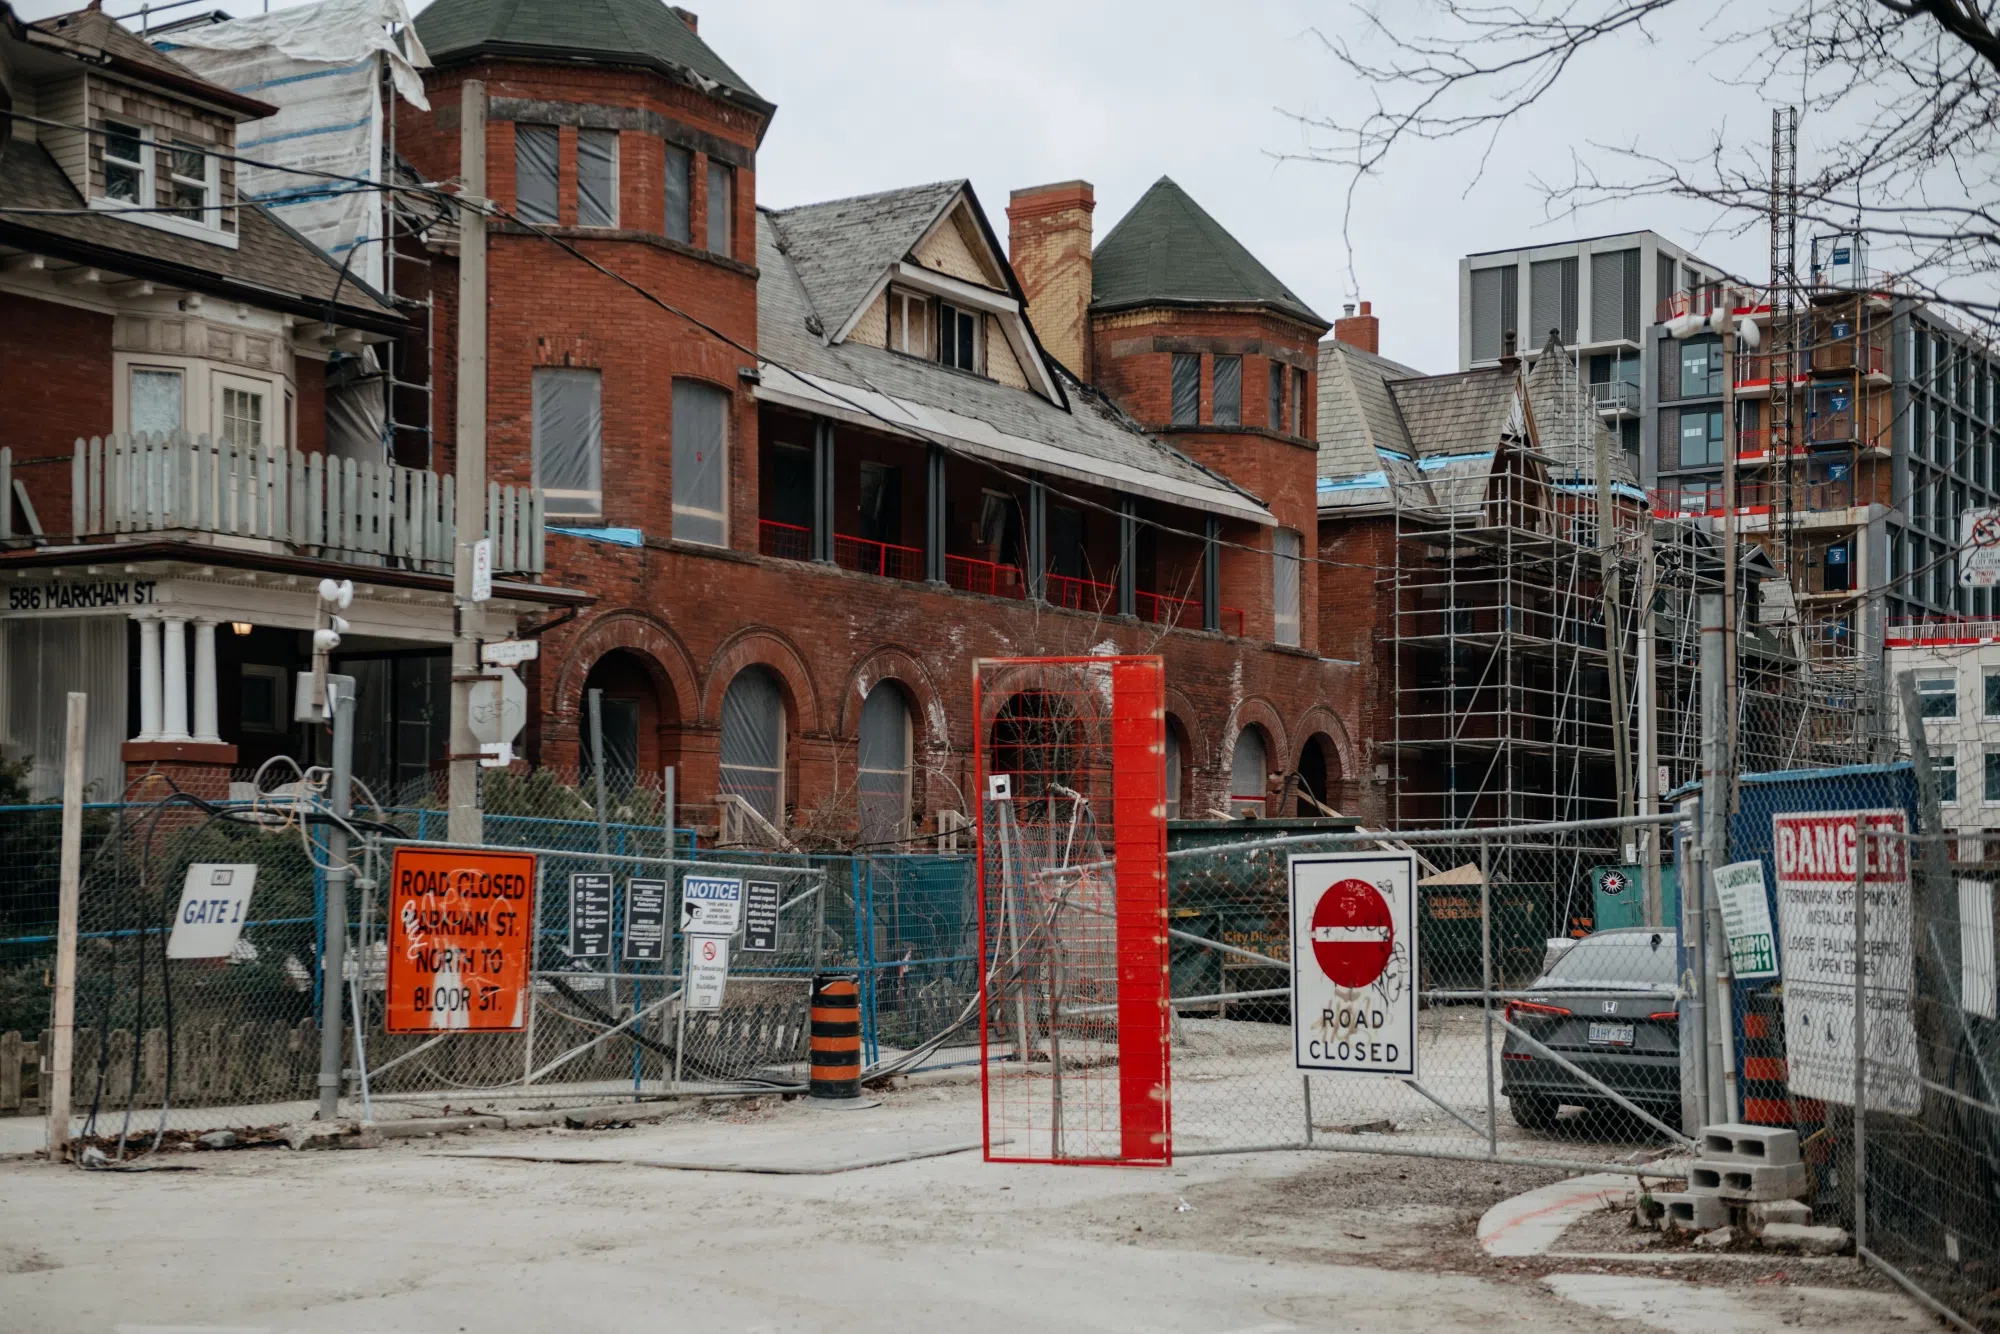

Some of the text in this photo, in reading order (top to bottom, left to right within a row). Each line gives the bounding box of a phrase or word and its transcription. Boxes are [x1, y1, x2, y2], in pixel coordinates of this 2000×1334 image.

[1837, 329, 1843, 337] 8
[9, 580, 159, 610] 586 MARKHAM ST.
[1779, 822, 1899, 874] DANGER
[400, 869, 525, 900] ROAD CLOSED
[687, 881, 738, 899] NOTICE
[1785, 889, 1833, 905] FORMWORK
[1836, 890, 1886, 906] STRIPING
[183, 899, 242, 924] GATE 1
[1807, 910, 1871, 926] INSTALLATIN
[496, 911, 519, 937] ST.
[1224, 931, 1248, 944] City
[1788, 936, 1816, 951] LOOSE
[415, 948, 503, 974] NORTH TO
[1817, 957, 1841, 973] OPEN
[1845, 960, 1876, 976] EDES
[413, 986, 502, 1011] BLOOR ST.
[1322, 1008, 1384, 1029] ROAD
[1309, 1040, 1399, 1062] CLOSED
